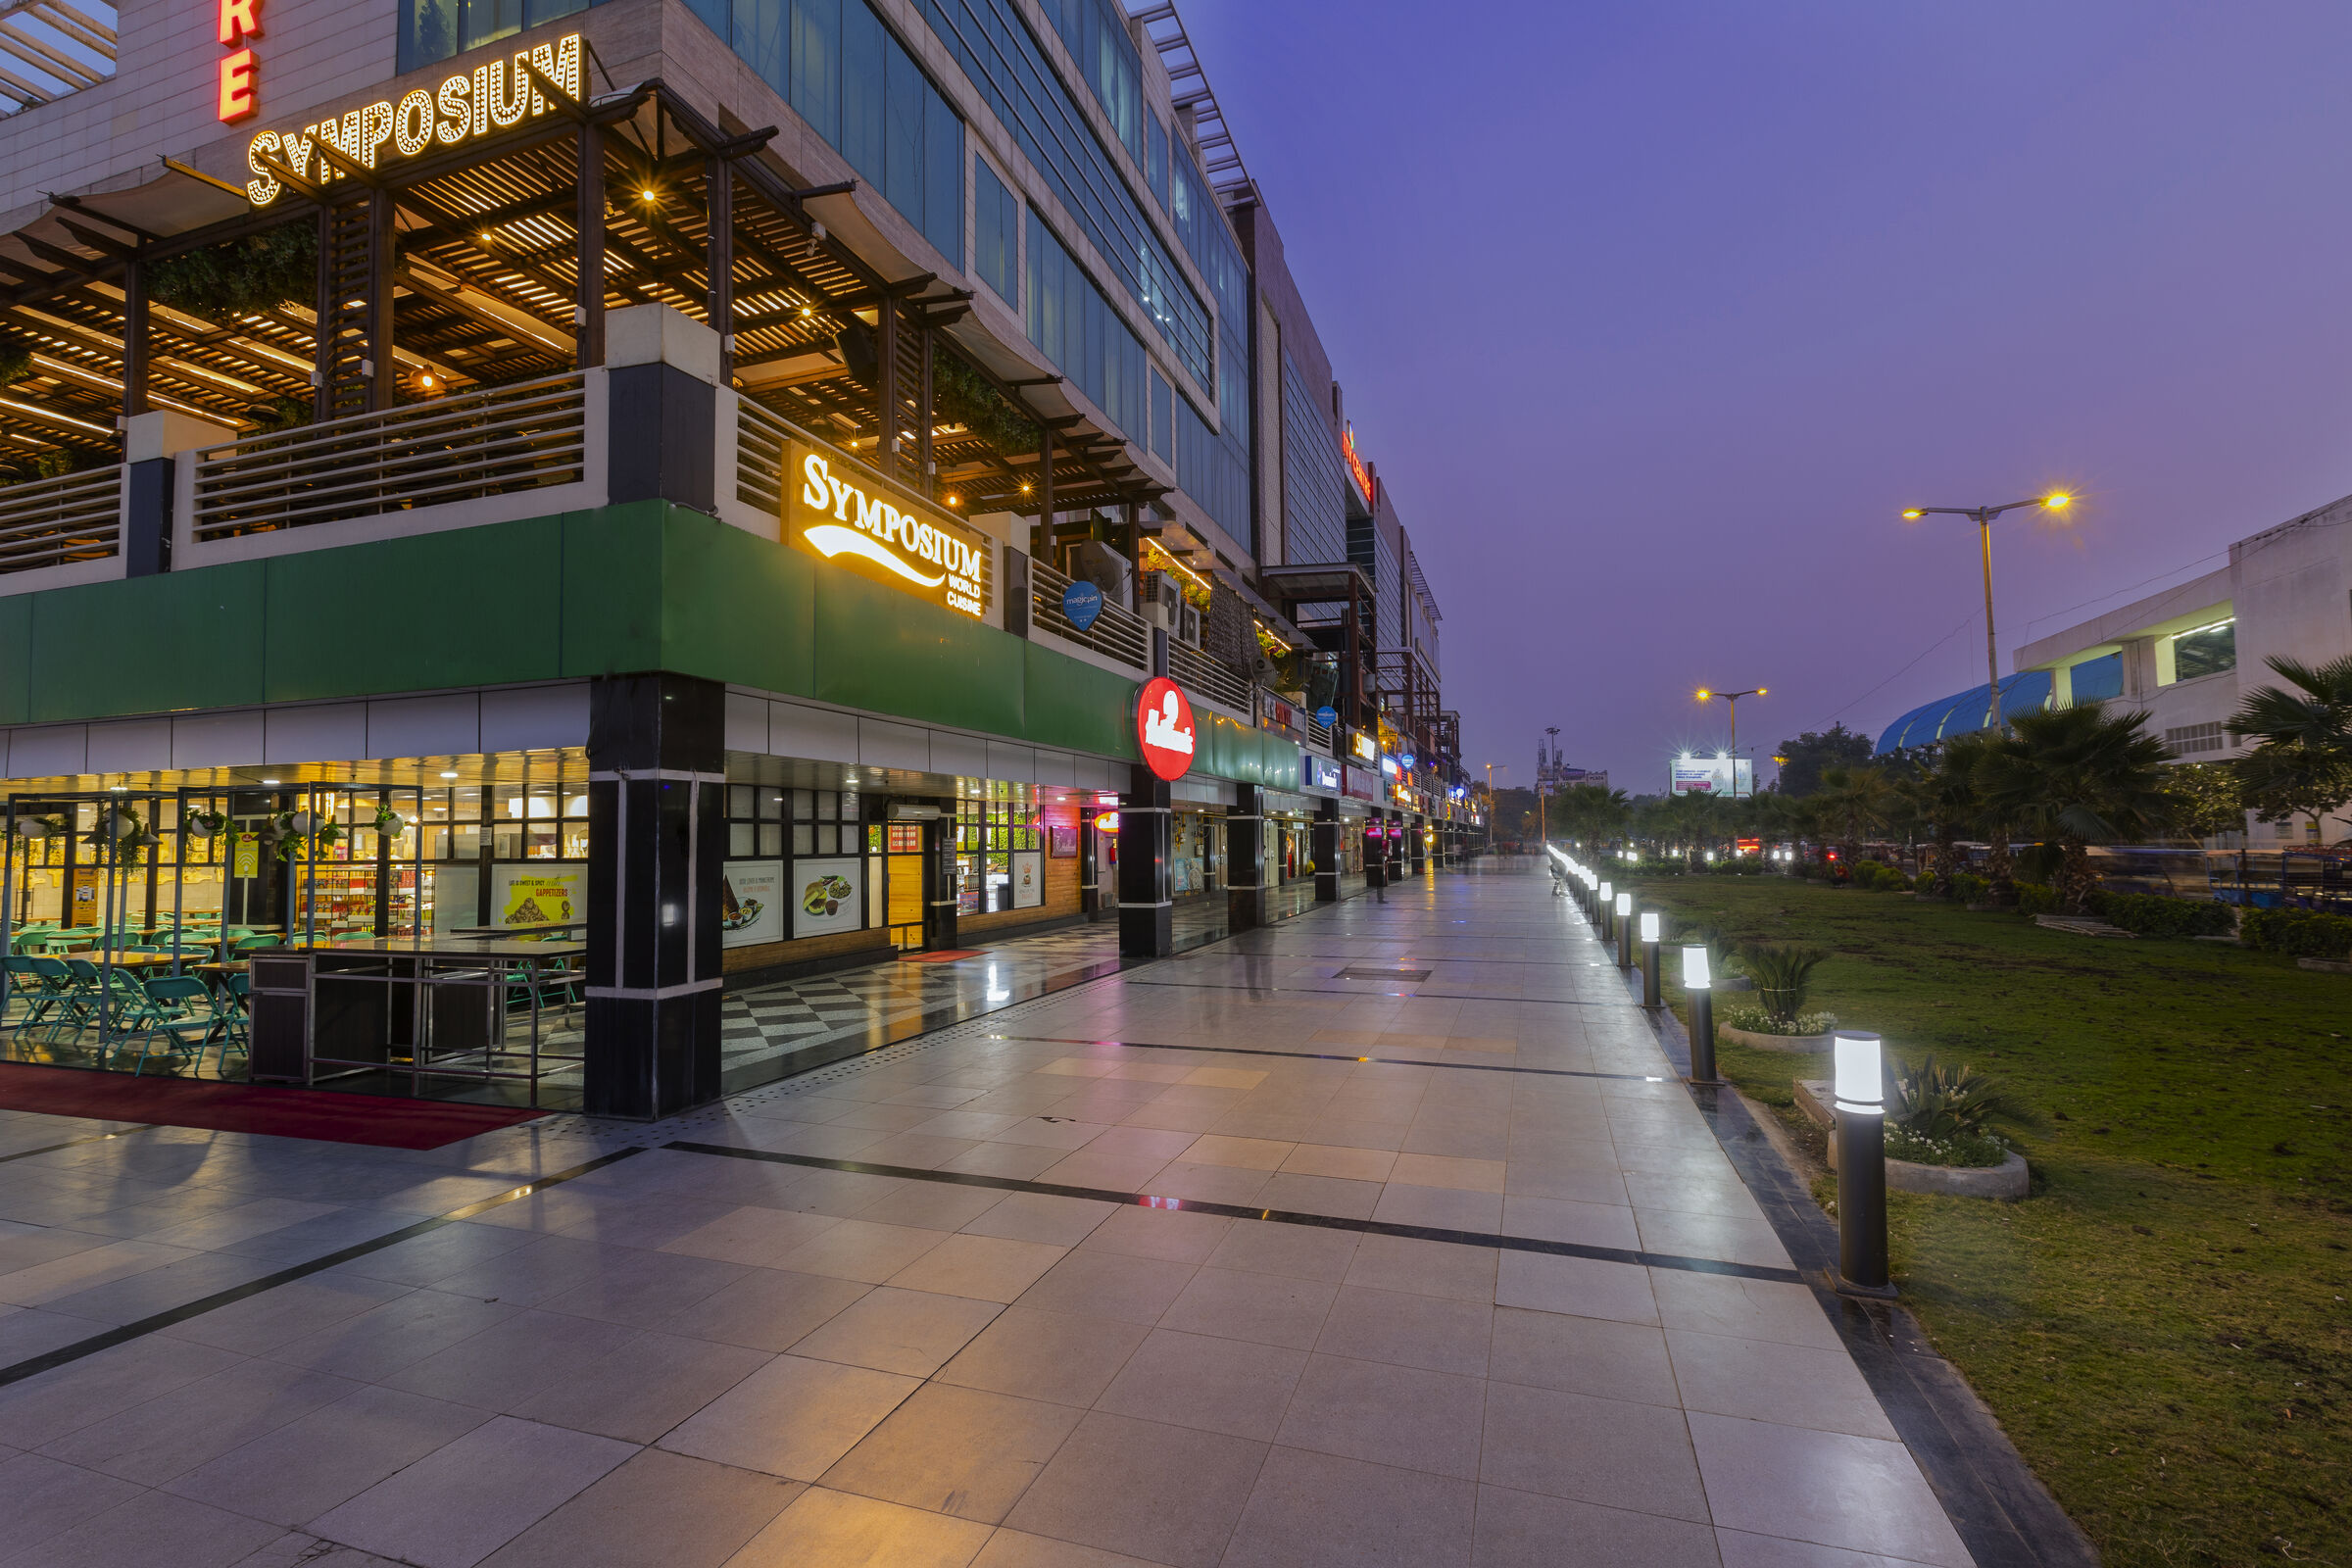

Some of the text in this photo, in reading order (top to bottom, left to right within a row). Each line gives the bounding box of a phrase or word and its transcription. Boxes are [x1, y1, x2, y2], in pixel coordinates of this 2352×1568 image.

[246, 32, 581, 206] SYMPOSIUM
[804, 454, 982, 583] SYMPOSIUM
[948, 573, 981, 599] WORLD
[947, 591, 982, 616] CUISINE
[1066, 595, 1098, 607] magicpin
[535, 888, 568, 897] GAPPETIZERS
